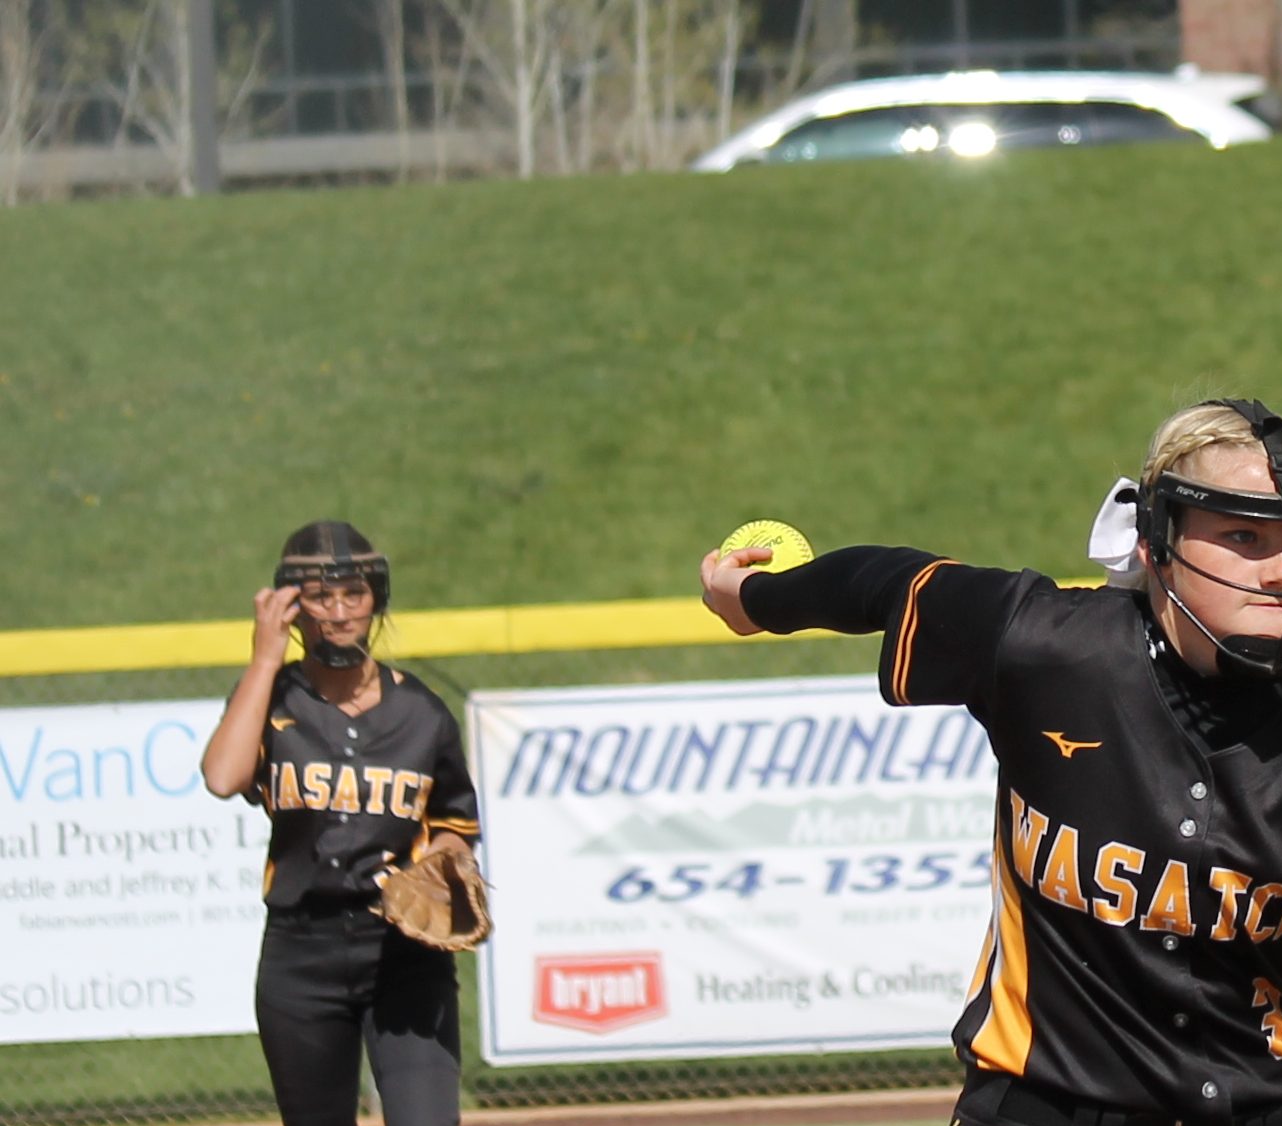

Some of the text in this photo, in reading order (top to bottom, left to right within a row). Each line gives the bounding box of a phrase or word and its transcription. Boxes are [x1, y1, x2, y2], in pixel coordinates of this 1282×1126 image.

[271, 761, 434, 822] ASATC
[56, 820, 216, 861] Property
[925, 800, 992, 839] Wo
[64, 874, 110, 898] and
[0, 972, 197, 1015] solutions
[549, 961, 965, 1013] bryant Heating & Cooling
